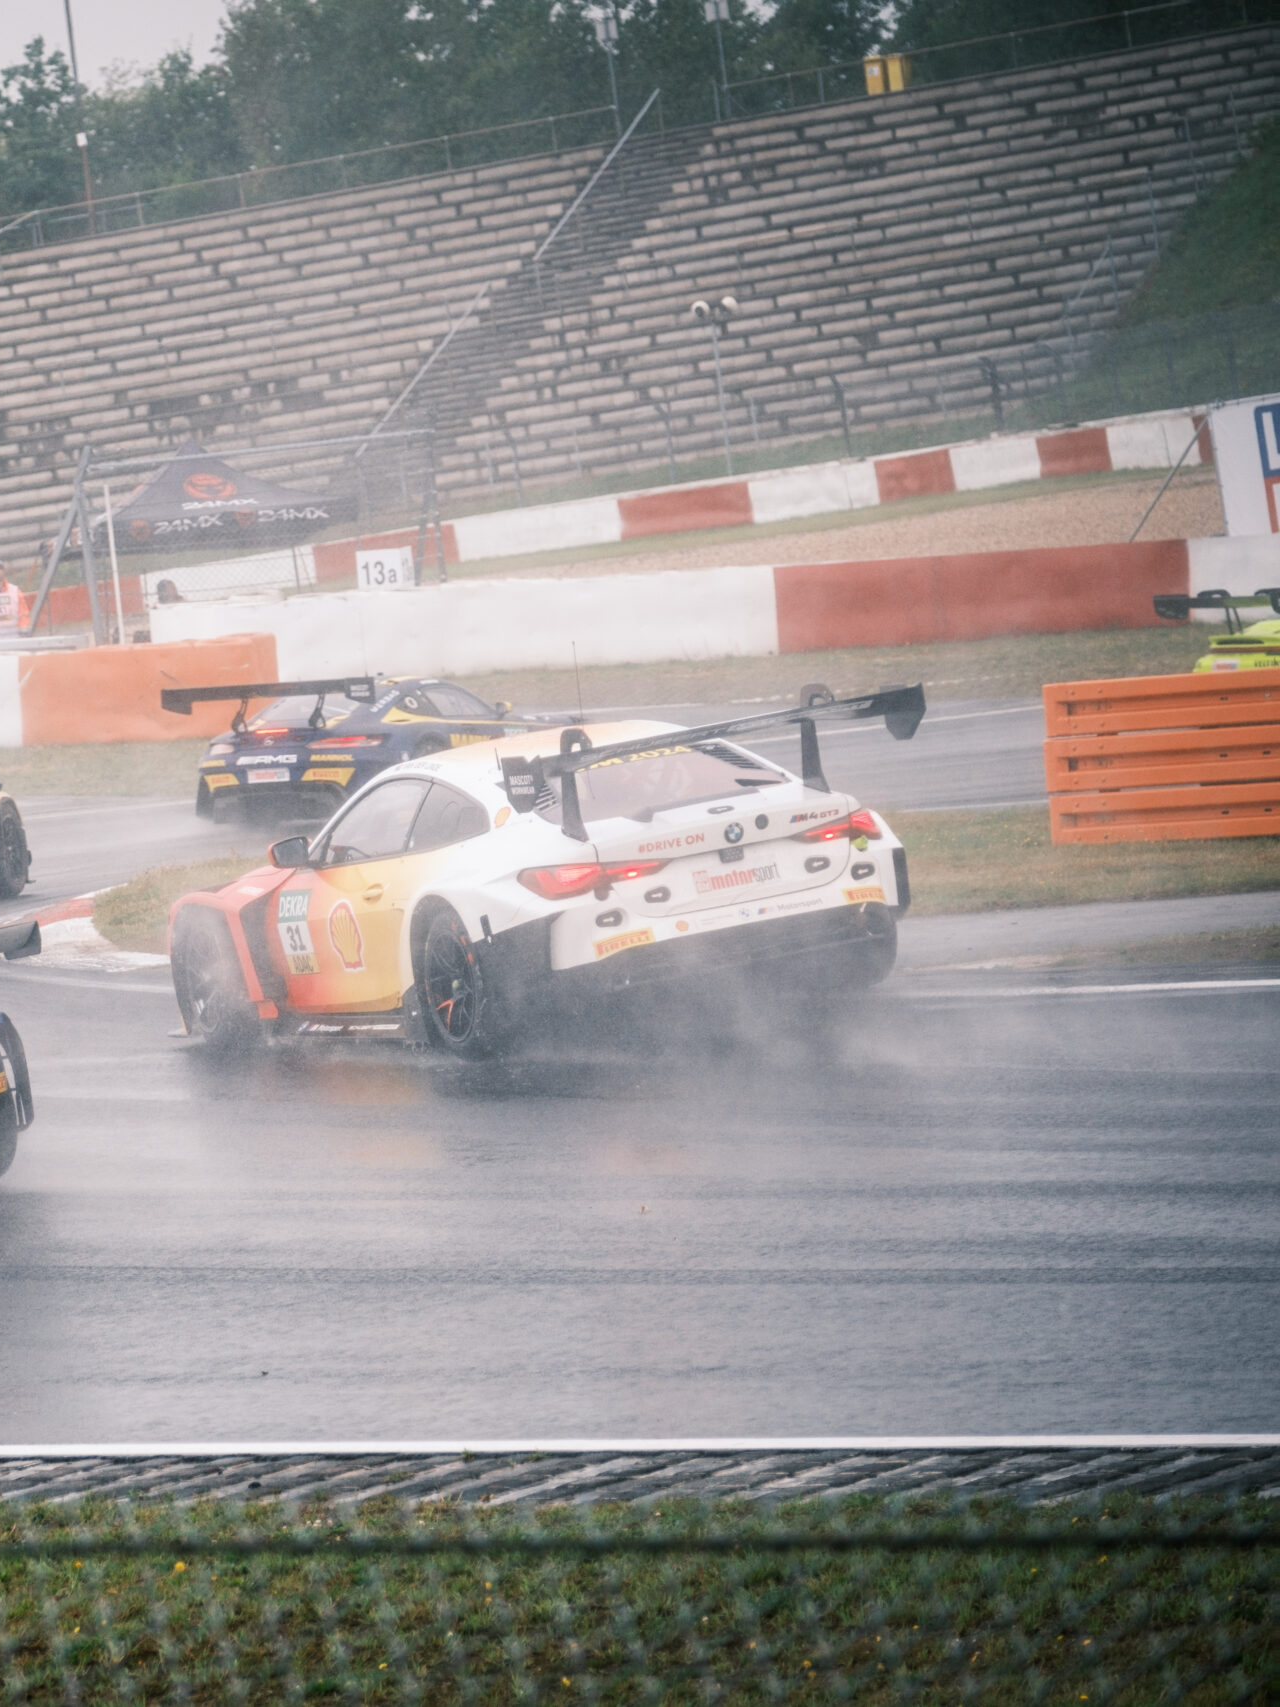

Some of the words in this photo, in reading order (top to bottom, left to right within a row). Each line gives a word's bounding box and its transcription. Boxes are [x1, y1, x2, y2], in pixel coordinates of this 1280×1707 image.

[153, 512, 224, 536] 24MX
[258, 506, 330, 523] 24MX
[361, 560, 398, 586] 13a
[253, 753, 298, 765] AMG
[629, 745, 693, 763] 2024
[637, 836, 683, 854] #DRIVE
[684, 832, 706, 846] ON
[710, 862, 781, 891] motorsport
[278, 894, 308, 918] DEKRA
[286, 924, 308, 952] 31
[595, 930, 652, 957] PIRELLI
